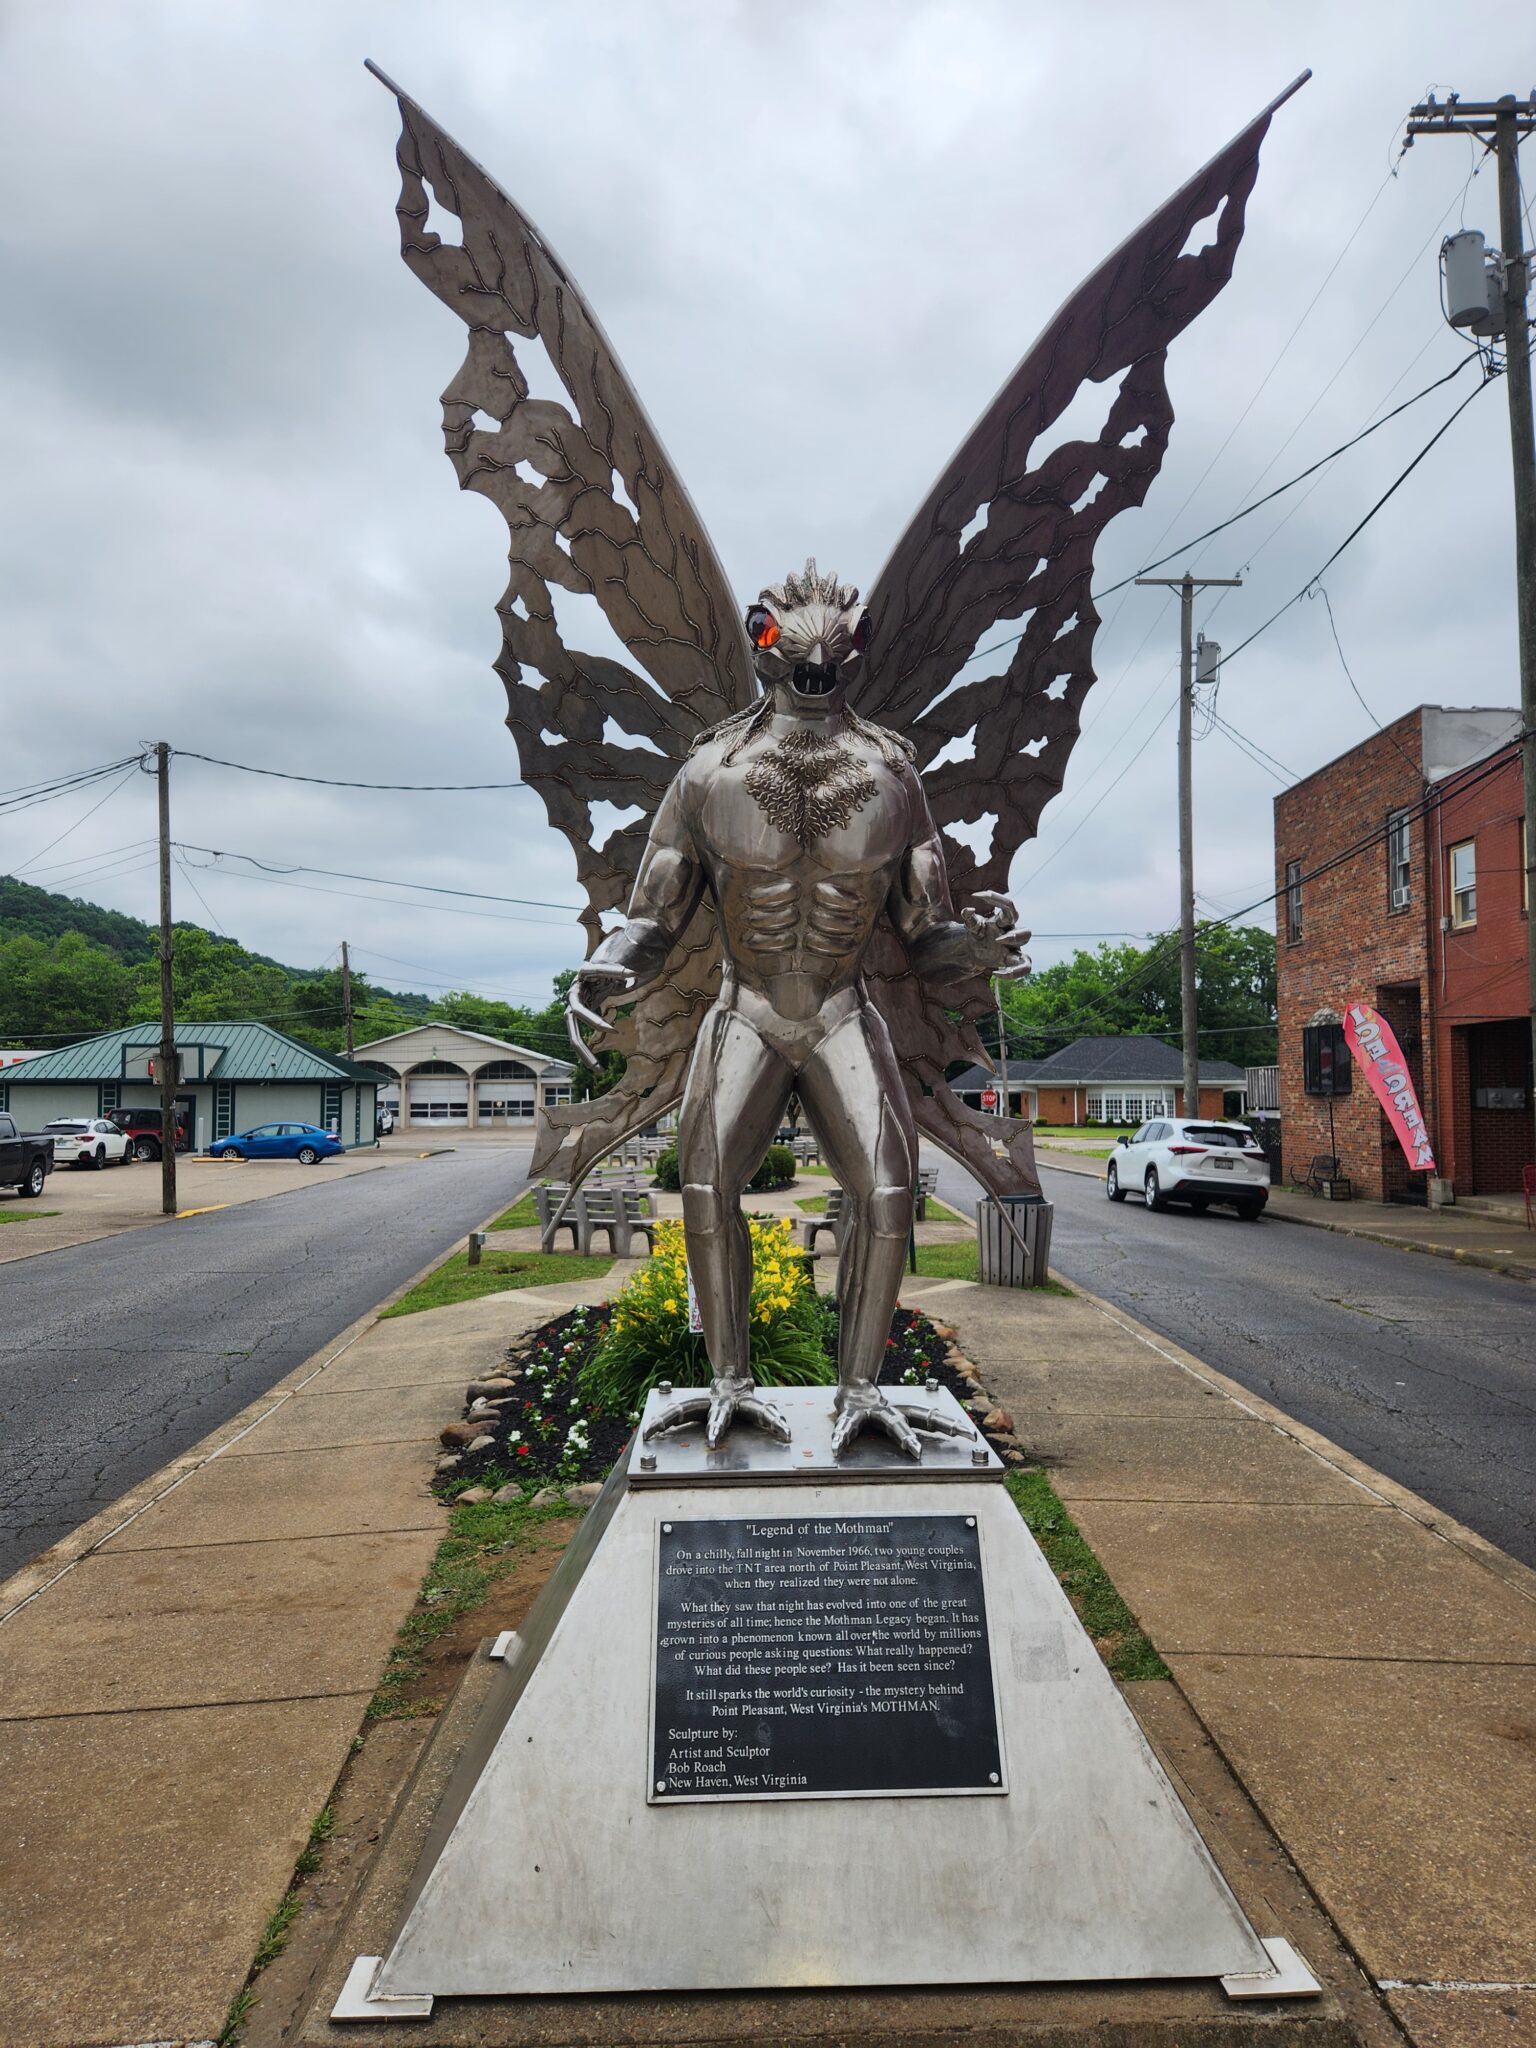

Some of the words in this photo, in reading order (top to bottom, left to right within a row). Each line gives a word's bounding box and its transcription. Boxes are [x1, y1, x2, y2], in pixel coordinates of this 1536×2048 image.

[798, 1523, 810, 1534] of
[814, 1523, 832, 1534] the
[676, 1550, 692, 1559] On
[704, 1549, 735, 1561] chilly,
[736, 1548, 753, 1558] fall
[755, 1548, 780, 1560] night
[783, 1548, 793, 1557] in
[797, 1547, 845, 1557] November
[849, 1546, 873, 1556] 1966,
[896, 1548, 926, 1557] young
[928, 1545, 964, 1557] couples
[666, 1565, 693, 1575] drove
[696, 1565, 715, 1574] into
[718, 1564, 734, 1573] the
[735, 1563, 761, 1573] TNT
[789, 1562, 816, 1572] north
[819, 1561, 831, 1571] of
[833, 1561, 858, 1571] Point
[861, 1561, 904, 1570] Pleasant,
[904, 1560, 928, 1569] West
[931, 1559, 976, 1571] Virginia,
[725, 1578, 751, 1588] when
[755, 1578, 775, 1590] they
[779, 1577, 820, 1587] realized
[824, 1577, 844, 1588] they
[873, 1577, 888, 1585] not
[890, 1575, 918, 1585] alone.
[681, 1602, 707, 1612] What
[710, 1602, 731, 1614] they
[757, 1601, 776, 1611] that
[779, 1600, 804, 1613] night
[807, 1600, 824, 1610] has
[826, 1599, 863, 1610] evolved
[867, 1599, 887, 1608] into
[909, 1598, 920, 1608] of
[923, 1598, 939, 1608] the
[941, 1599, 967, 1610] great
[667, 1618, 715, 1631] mysteries
[717, 1618, 728, 1627] of
[730, 1617, 743, 1627] all
[774, 1616, 803, 1626] hence
[805, 1615, 821, 1625] the
[824, 1615, 872, 1625] Mothman
[875, 1614, 912, 1626] Legacy
[916, 1613, 949, 1626] began.
[952, 1613, 960, 1622] It
[962, 1613, 980, 1622] has
[663, 1637, 695, 1647] grown
[699, 1634, 719, 1644] into
[731, 1633, 794, 1646] phenomenon
[798, 1631, 832, 1641] known
[835, 1630, 848, 1640] all
[874, 1630, 890, 1640] the
[893, 1629, 920, 1639] world
[924, 1629, 936, 1641] by
[939, 1628, 982, 1638] millions
[674, 1650, 687, 1660] of
[689, 1649, 726, 1660] curious
[729, 1648, 762, 1662] people
[764, 1648, 800, 1660] asking
[802, 1646, 853, 1660] questions:
[855, 1646, 883, 1655] What
[885, 1645, 915, 1657] really
[918, 1643, 972, 1657] happened?
[694, 1665, 722, 1675] What
[725, 1665, 741, 1675] did
[745, 1664, 771, 1674] these
[774, 1663, 808, 1677] people
[809, 1662, 832, 1673] see?
[837, 1662, 857, 1672] Has
[859, 1662, 867, 1672] it
[869, 1661, 894, 1672] been
[897, 1663, 921, 1671] seen
[924, 1660, 956, 1670] since?
[686, 1690, 694, 1700] It
[696, 1689, 716, 1700] still
[718, 1689, 752, 1702] sparks
[755, 1688, 770, 1698] the
[773, 1687, 808, 1698] world's
[810, 1686, 856, 1699] curiosity
[866, 1685, 881, 1696] the
[884, 1686, 926, 1698] mystery
[928, 1683, 964, 1694] behind
[712, 1705, 738, 1716] Point
[742, 1705, 787, 1715] Pleasant,
[789, 1704, 814, 1714] West
[817, 1702, 868, 1716] Virginia's
[669, 1728, 719, 1742] Sculpture
[722, 1727, 738, 1741] by:
[669, 1747, 701, 1758] Artist
[704, 1746, 723, 1758] and
[727, 1746, 770, 1759] Sculptor
[669, 1762, 690, 1773] Bob
[694, 1761, 726, 1772] Roach
[669, 1777, 692, 1788] New
[696, 1776, 732, 1787] Haven,
[734, 1775, 758, 1786] West
[761, 1774, 808, 1787] Virginia
